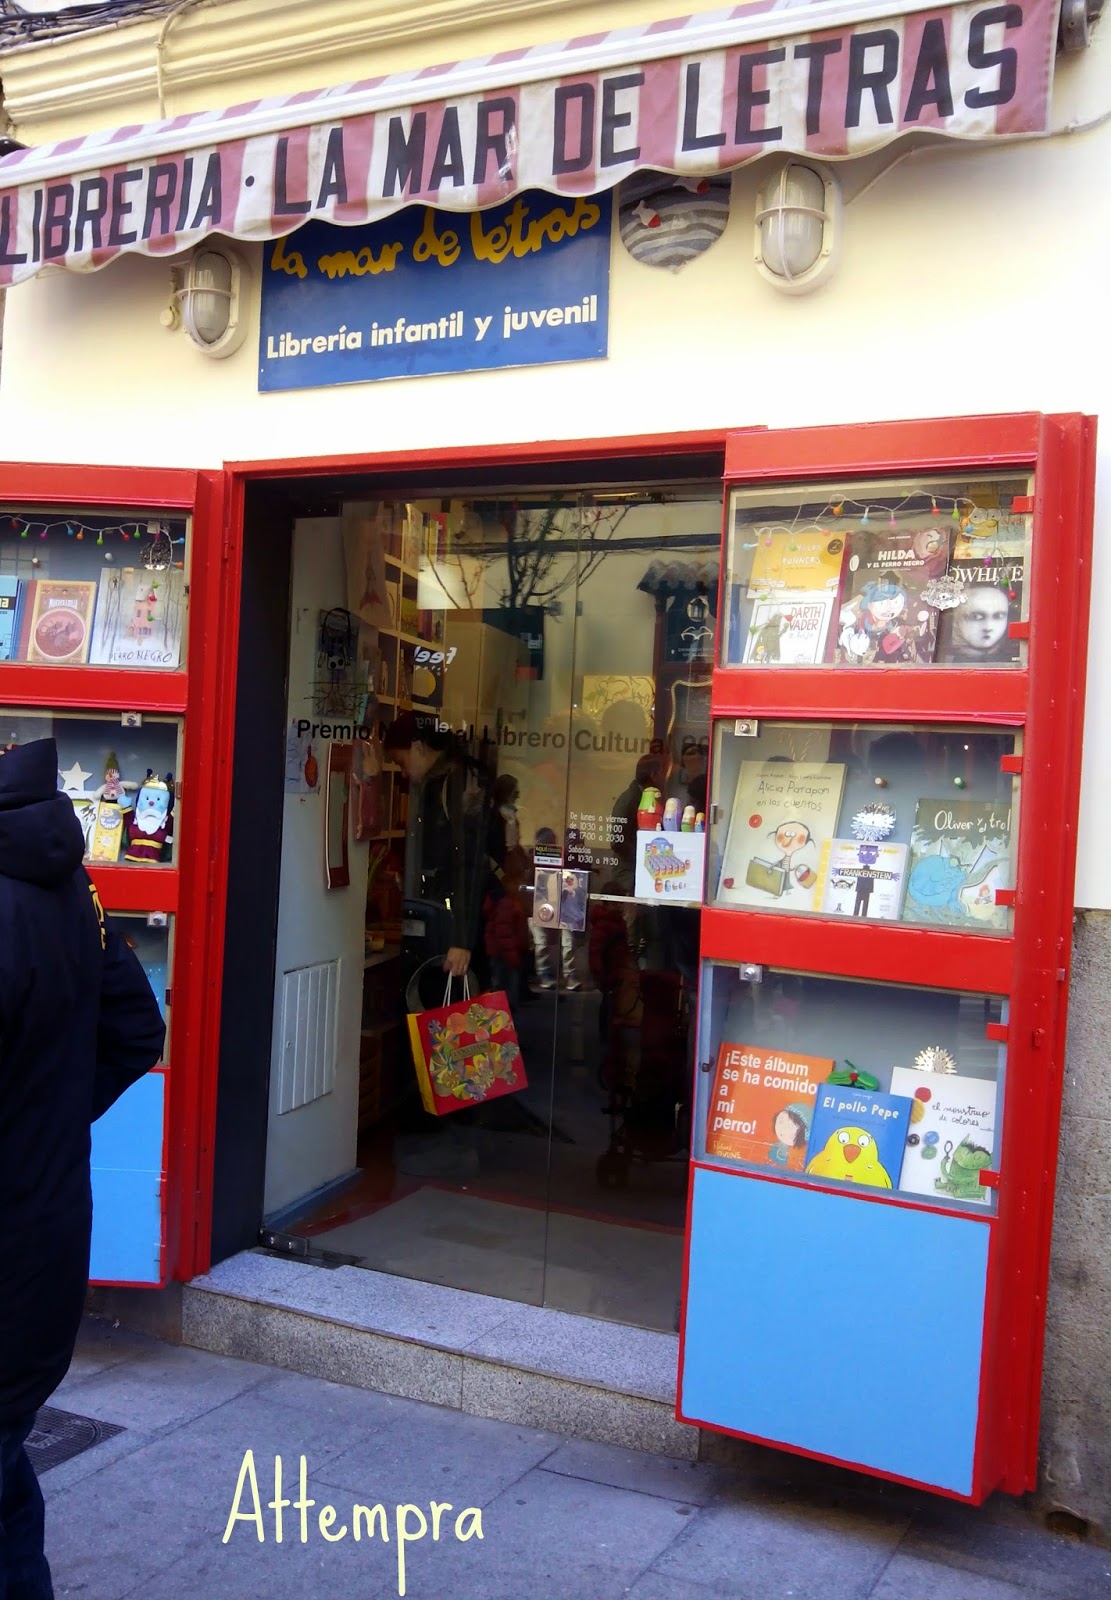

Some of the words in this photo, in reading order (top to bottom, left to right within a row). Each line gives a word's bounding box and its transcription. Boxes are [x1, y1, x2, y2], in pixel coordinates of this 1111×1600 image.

[0, 152, 222, 266] LIBRERIA
[273, 128, 345, 216] LA
[382, 97, 516, 198] MAR
[552, 72, 645, 176] DE
[681, 4, 1023, 153] LETRAS
[318, 240, 403, 279] mar
[413, 205, 462, 267] de
[470, 196, 601, 264] letras
[266, 325, 362, 359] Librería
[371, 311, 464, 347] infantil
[475, 315, 493, 342] y
[504, 295, 598, 338] juvenil
[878, 549, 915, 561] HILDA
[791, 606, 822, 619] DARTH
[789, 619, 819, 631] VADER
[137, 649, 173, 662] NEGRO
[297, 719, 371, 741] Premio
[483, 724, 566, 749] Librero
[758, 780, 784, 795] Alicia
[769, 799, 781, 807] los
[784, 800, 822, 811] cuentos
[570, 812, 578, 820] De
[580, 812, 596, 821] lunes
[605, 815, 628, 823] viernes
[934, 810, 974, 830] Oliver
[989, 808, 1011, 832] trol
[569, 822, 577, 830] de
[569, 831, 577, 839] de
[839, 869, 893, 880] FRANKENSTEIN
[725, 1050, 761, 1069] ¡Este
[764, 1056, 809, 1077] álbum
[722, 1068, 739, 1082] se
[742, 1069, 760, 1085] ha
[763, 1076, 818, 1095] comido
[719, 1084, 728, 1096] a
[716, 1100, 735, 1114] mi
[823, 1097, 835, 1108] El
[837, 1101, 867, 1113] pollo
[871, 1104, 899, 1120] Pepe
[932, 1102, 940, 1111] el
[943, 1105, 991, 1118] monstruo
[713, 1116, 757, 1135] perro!
[951, 1115, 979, 1126] colores
